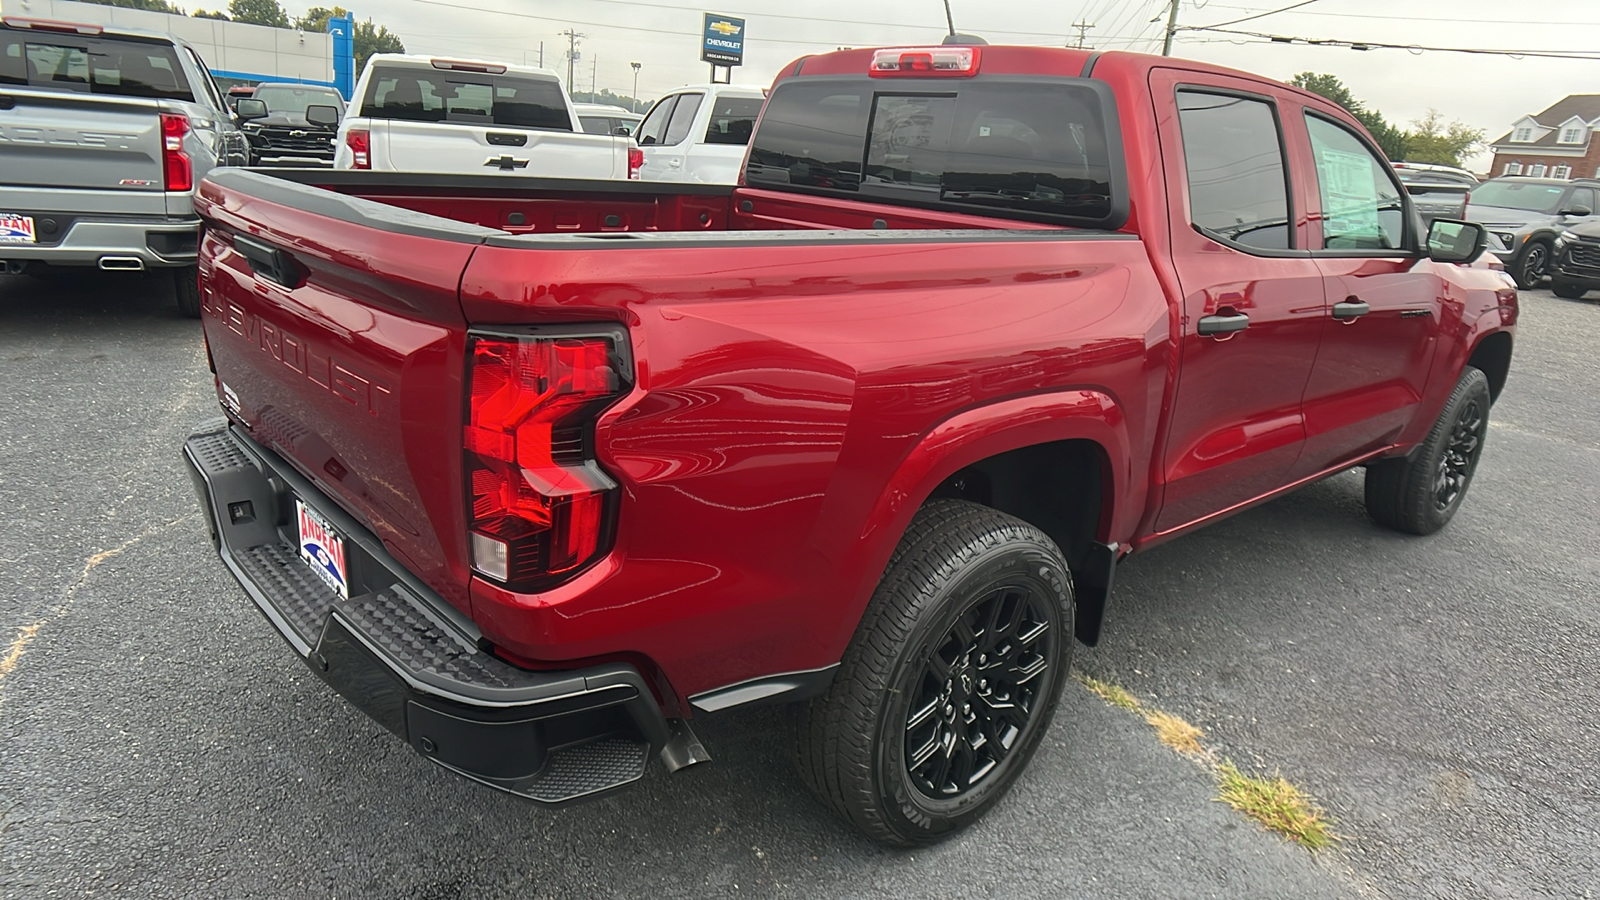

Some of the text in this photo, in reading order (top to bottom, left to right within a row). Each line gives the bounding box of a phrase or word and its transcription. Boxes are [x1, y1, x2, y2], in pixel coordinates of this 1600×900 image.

[706, 38, 741, 49] CHEVROLET
[0, 125, 138, 149] OLET
[0, 219, 31, 234] EAN
[201, 284, 391, 417] CHEVROLET
[301, 508, 347, 582] ANDEAN
